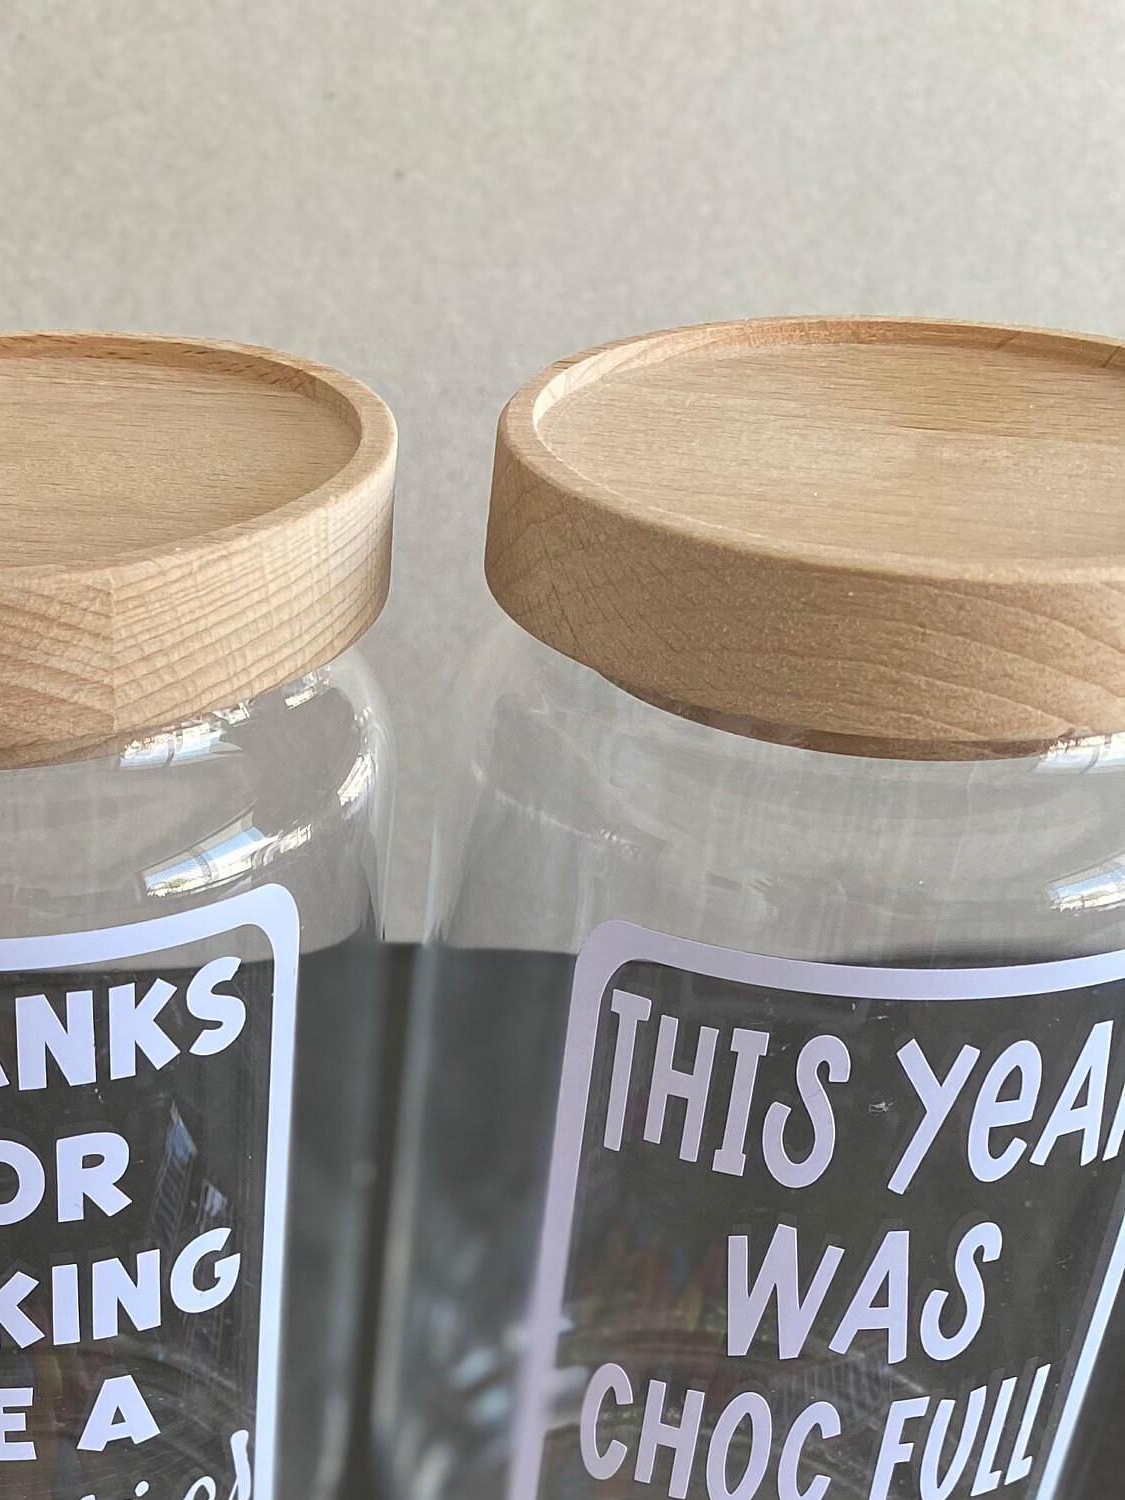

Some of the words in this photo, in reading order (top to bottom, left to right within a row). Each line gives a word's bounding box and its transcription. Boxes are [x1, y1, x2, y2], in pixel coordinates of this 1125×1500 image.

[603, 988, 852, 1189] THIS
[726, 1221, 1003, 1364] WAS
[76, 1374, 160, 1452] A
